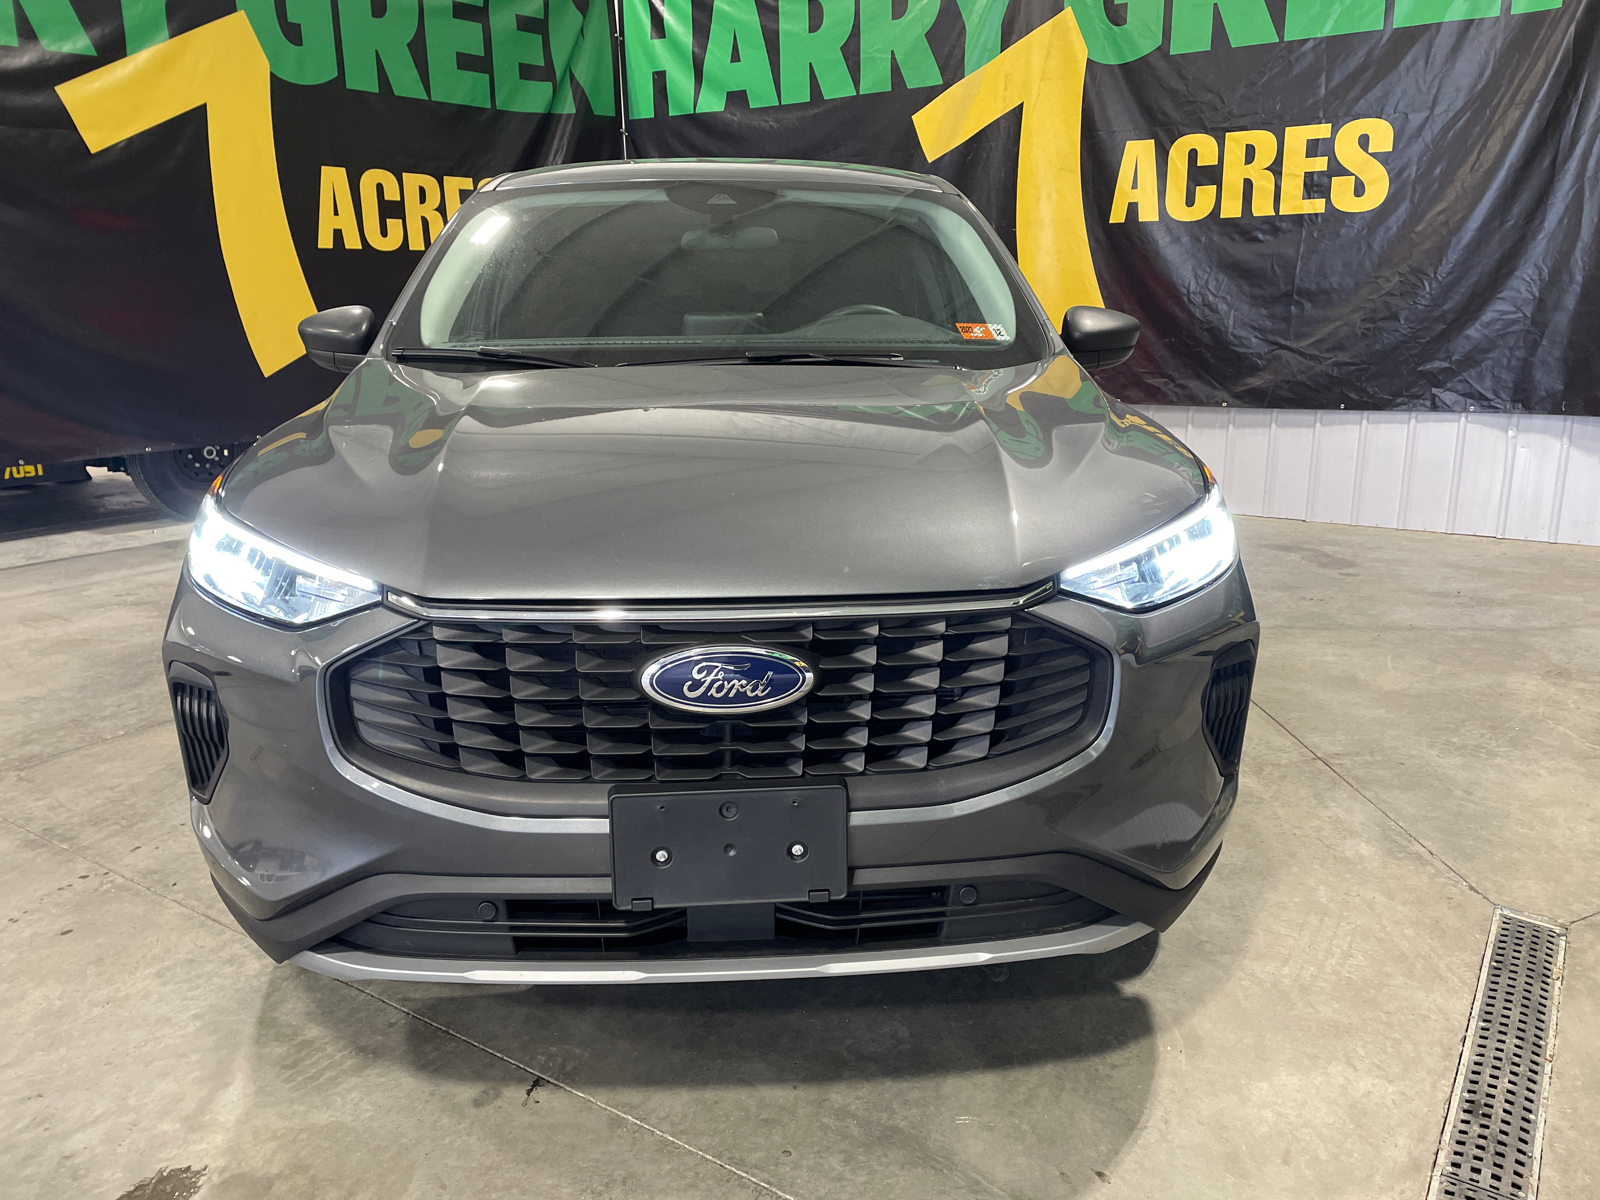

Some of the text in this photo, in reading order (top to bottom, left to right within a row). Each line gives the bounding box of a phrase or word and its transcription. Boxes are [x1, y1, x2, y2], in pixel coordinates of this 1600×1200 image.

[54, 9, 318, 377] 7
[318, 166, 493, 251] ACRE
[912, 6, 1105, 334] 7
[1109, 118, 1394, 224] ACRES
[682, 661, 774, 699] Ford
